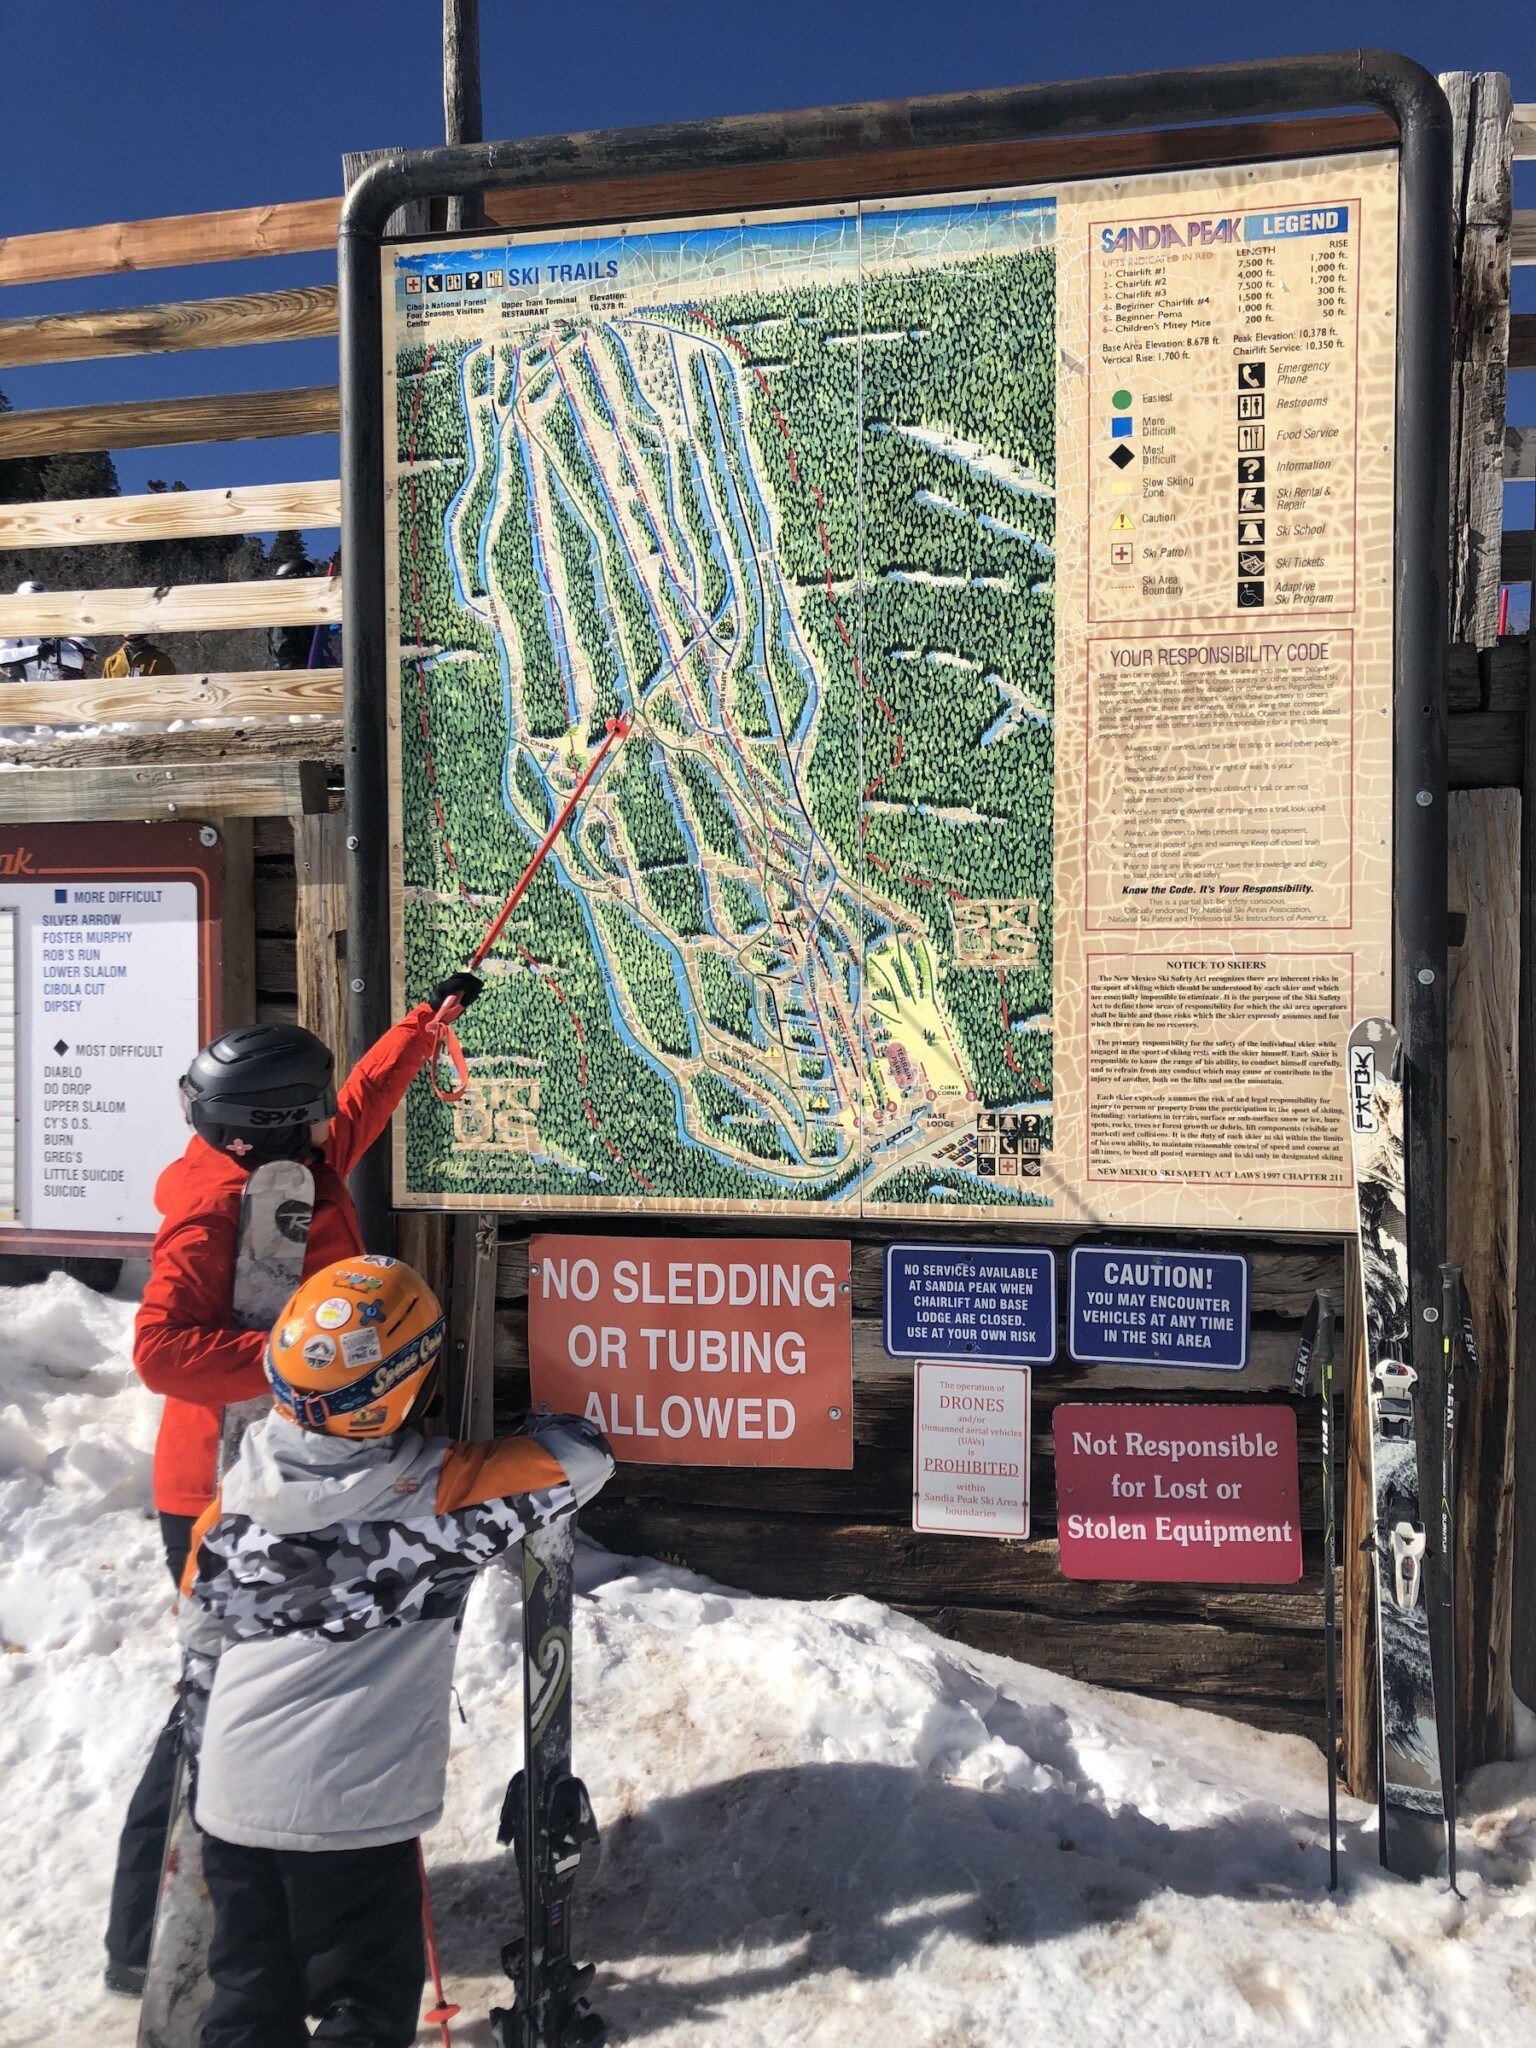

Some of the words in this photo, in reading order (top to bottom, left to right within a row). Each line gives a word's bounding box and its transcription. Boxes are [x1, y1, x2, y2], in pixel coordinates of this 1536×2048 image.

[1263, 212, 1339, 235] LEGEND
[1101, 222, 1186, 253] SANDIA
[1188, 218, 1242, 247] PEAK
[1330, 240, 1349, 249] RISE
[1236, 246, 1276, 257] LENGTH
[508, 266, 539, 287] SKI
[548, 260, 618, 283] TRAILS
[502, 301, 523, 310] Upper
[546, 296, 577, 305] Terminal
[590, 292, 627, 302] Elevation:
[406, 304, 429, 312] Cibola
[432, 301, 461, 309] National
[464, 298, 487, 306] Forest
[406, 312, 423, 320] Four
[425, 310, 455, 318] Seasons
[502, 308, 548, 318] RESTAURANT
[406, 320, 430, 328] Center
[1277, 362, 1331, 375] Emergency
[1277, 374, 1308, 385] Phone
[1142, 393, 1173, 404] Easiest
[1276, 397, 1328, 409] Restrooms
[1142, 416, 1165, 426] More
[1142, 426, 1176, 437] Difficult
[1276, 430, 1302, 441] Food
[1304, 428, 1339, 440] Service
[1142, 445, 1165, 455] Most
[1142, 454, 1176, 465] Difficult
[1276, 460, 1332, 472] Information
[1143, 478, 1164, 488] Slow
[1167, 476, 1194, 487] Skiing
[1143, 488, 1164, 498] Zone
[1276, 488, 1292, 499] Ski
[1294, 486, 1323, 498] Rental
[1324, 486, 1331, 496] &
[1277, 500, 1306, 512] Repair
[1142, 513, 1176, 523] Caution
[1276, 525, 1291, 536] Ski
[1293, 524, 1326, 536] School
[1143, 548, 1158, 559] Ski
[1160, 546, 1188, 557] Patrol
[1276, 558, 1291, 569] Ski
[1294, 556, 1325, 568] Tickets
[1142, 576, 1155, 586] Ski
[1158, 575, 1178, 585] Area
[1143, 586, 1184, 596] Boundary
[1275, 582, 1316, 594] Adaptive
[1275, 594, 1290, 605] Ski
[1293, 594, 1333, 606] Program
[1110, 649, 1153, 668] YOUR
[1158, 644, 1282, 666] RESPONSIBILITY
[1286, 642, 1330, 662] CODE
[1122, 886, 1148, 895] Know
[1151, 886, 1166, 894] the
[1169, 885, 1196, 894] Code.
[1200, 884, 1216, 894] It's
[1219, 884, 1240, 894] Your
[1242, 884, 1314, 895] Responsibility.
[74, 892, 105, 904] MORE
[109, 890, 163, 903] DIFFICULT
[42, 914, 78, 926] SILVER
[81, 914, 122, 926] ARROW
[43, 932, 83, 944] FOSTER
[86, 932, 133, 943] MURPHY
[44, 949, 75, 961] ROB'S
[78, 949, 101, 961] RUN
[1166, 960, 1208, 970] NOTICE
[1210, 961, 1225, 970] TO
[1227, 961, 1267, 970] SKIERS
[44, 966, 81, 978] LOWER
[84, 966, 127, 978] SLALOM
[44, 984, 81, 995] CIBOLA
[85, 984, 105, 995] CUT
[44, 1000, 82, 1012] DIPSEY
[76, 1045, 106, 1057] MOST
[110, 1046, 163, 1058] DIFFICULT
[897, 1048, 913, 1081] TERRAIN
[44, 1066, 82, 1078] DIABLO
[44, 1083, 59, 1095] DO
[62, 1084, 92, 1095] DROP
[44, 1100, 79, 1112] UPPER
[82, 1101, 126, 1113] SLALOM
[927, 1112, 947, 1120] BASE
[44, 1118, 68, 1129] CY'S
[72, 1118, 92, 1130] O.S.
[926, 1120, 955, 1128] LODGE
[44, 1134, 74, 1146] BURN
[44, 1151, 83, 1163] GREG'S
[44, 1168, 79, 1181] LITTLE
[82, 1170, 125, 1182] SUICIDE
[1097, 1168, 1118, 1176] NEW
[1120, 1168, 1158, 1177] MEXICO
[1177, 1170, 1211, 1178] SAFETY
[1214, 1170, 1232, 1179] ACT
[1234, 1171, 1260, 1180] LAWS
[1263, 1172, 1280, 1180] 1997
[1282, 1172, 1327, 1181] CHAPTER
[1330, 1174, 1343, 1182] 211
[44, 1185, 86, 1198] SUICIDE
[904, 1264, 919, 1276] NO
[923, 1265, 976, 1278] SERVICES
[979, 1266, 1038, 1280] AVAILABLE
[1104, 1262, 1213, 1290] CAUTION!
[542, 1258, 600, 1302] NO
[614, 1260, 836, 1308] SLEDDING
[908, 1280, 922, 1291] AT
[925, 1281, 965, 1293] SANDIA
[968, 1282, 997, 1294] PEAK
[1000, 1284, 1033, 1295] WHEN
[914, 1296, 971, 1309] CHAIRLIFT
[974, 1298, 997, 1310] AND
[1000, 1299, 1029, 1311] BASE
[1087, 1292, 1113, 1306] YOU
[1118, 1293, 1146, 1307] MAY
[1150, 1294, 1230, 1312] ENCOUNTER
[916, 1312, 951, 1324] LODGE
[954, 1314, 976, 1325] ARE
[980, 1314, 1026, 1326] CLOSED.
[1082, 1310, 1146, 1326] VEHICLES
[1150, 1313, 1166, 1327] AT
[1170, 1314, 1197, 1329] ANY
[1200, 1316, 1234, 1332] TIME
[907, 1326, 928, 1338] USE
[931, 1328, 945, 1339] AT
[948, 1328, 978, 1341] YOUR
[981, 1330, 1007, 1342] OWN
[1010, 1331, 1037, 1343] RISK
[1104, 1329, 1118, 1343] IN
[1122, 1330, 1146, 1344] THE
[1151, 1332, 1172, 1346] SKI
[1176, 1334, 1212, 1349] AREA
[568, 1324, 627, 1369] OR
[640, 1328, 806, 1375] TUBING
[1295, 1345, 1310, 1387] LEKI
[939, 1381, 955, 1390] The
[956, 1382, 995, 1392] operation
[996, 1384, 1006, 1393] of
[940, 1396, 1005, 1413] DRONES
[584, 1392, 796, 1440] ALLOWED
[958, 1415, 986, 1424] and/or
[921, 1424, 964, 1434] Unmanned
[966, 1426, 989, 1436] aerial
[990, 1428, 1023, 1437] vehicles
[958, 1437, 985, 1447] (UAVs)
[1072, 1432, 1118, 1456] Not
[1125, 1432, 1279, 1462] Responsible
[968, 1448, 975, 1456] is
[924, 1458, 1019, 1477] PROHIBITED
[956, 1483, 986, 1493] within
[1112, 1474, 1146, 1498] for
[1154, 1475, 1208, 1500] Lost
[1216, 1482, 1243, 1500] or
[924, 1492, 955, 1503] Sandia
[957, 1495, 979, 1505] Peak
[980, 1496, 994, 1506] Ski
[996, 1498, 1018, 1507] Area
[945, 1506, 997, 1518] boundaries
[1068, 1514, 1147, 1541] Stolen
[1155, 1516, 1293, 1548] Equipment
